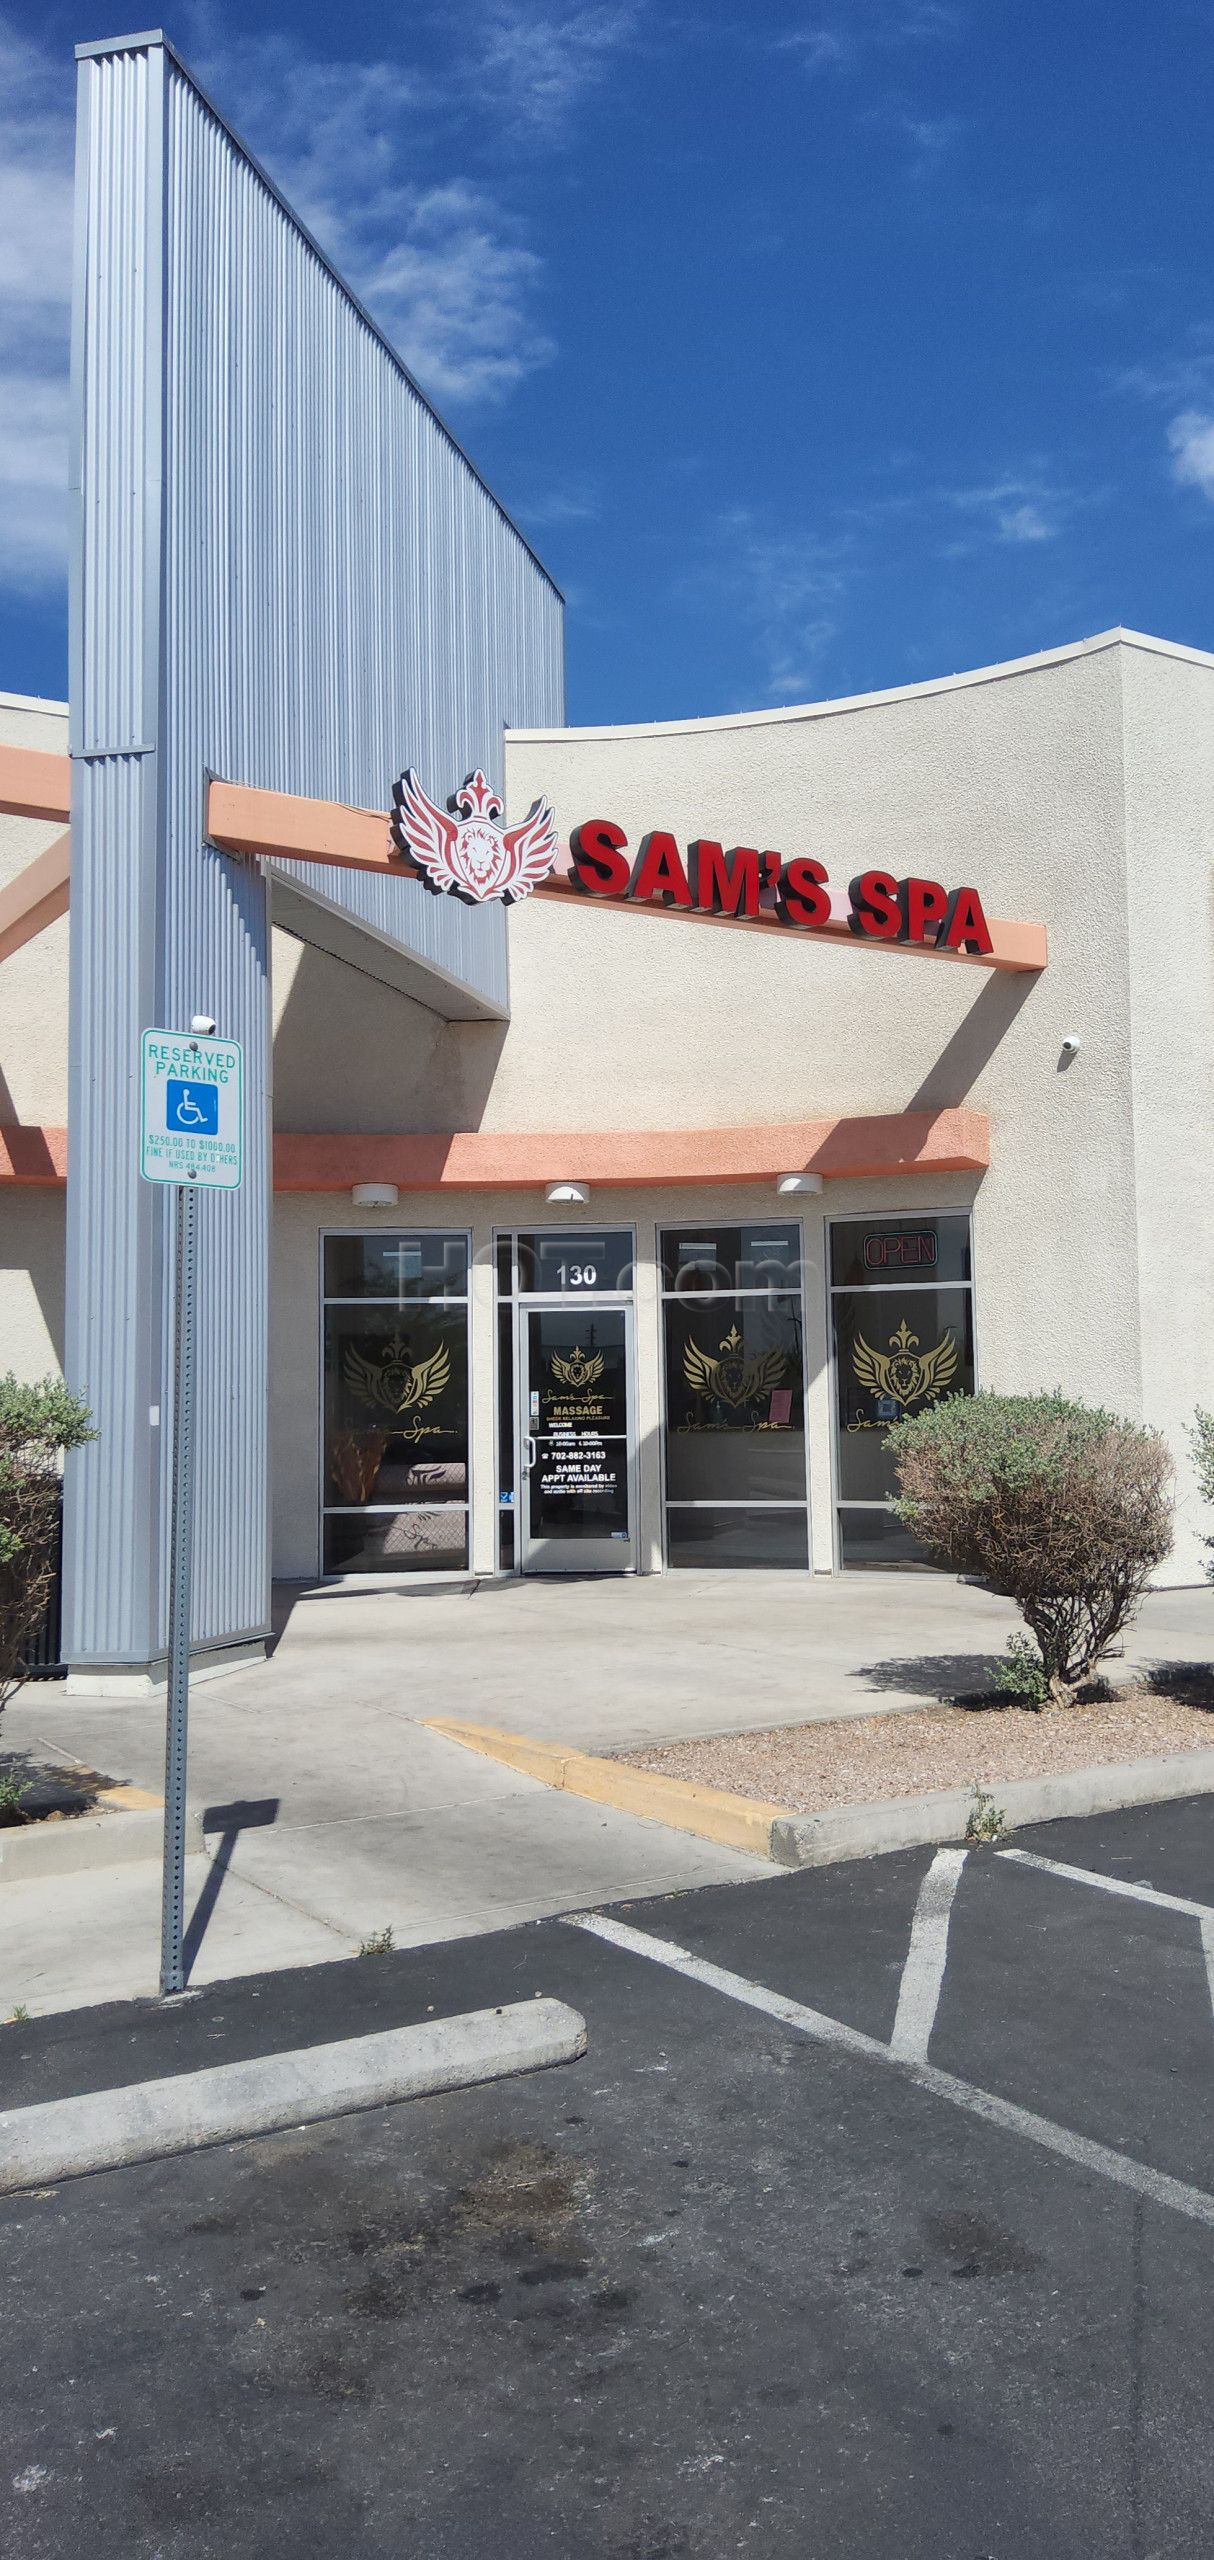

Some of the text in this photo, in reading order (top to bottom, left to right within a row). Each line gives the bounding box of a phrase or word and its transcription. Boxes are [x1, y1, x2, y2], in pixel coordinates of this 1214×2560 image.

[568, 819, 994, 955] SAM'S SPA
[149, 1044, 236, 1069] RESERVED
[156, 1061, 229, 1084] PARKING
[149, 1135, 236, 1153] $250.00 TO $1000.00
[146, 1146, 238, 1165] FINE IF USED BY OHERS
[866, 1235, 935, 1265] OPEN
[556, 1264, 597, 1285] 130
[553, 1406, 603, 1415] MASSAGE
[551, 1451, 606, 1460] 702-882-3163
[541, 1473, 616, 1482] APPT AVAILABLE
[556, 1464, 601, 1473] SAME DAY
